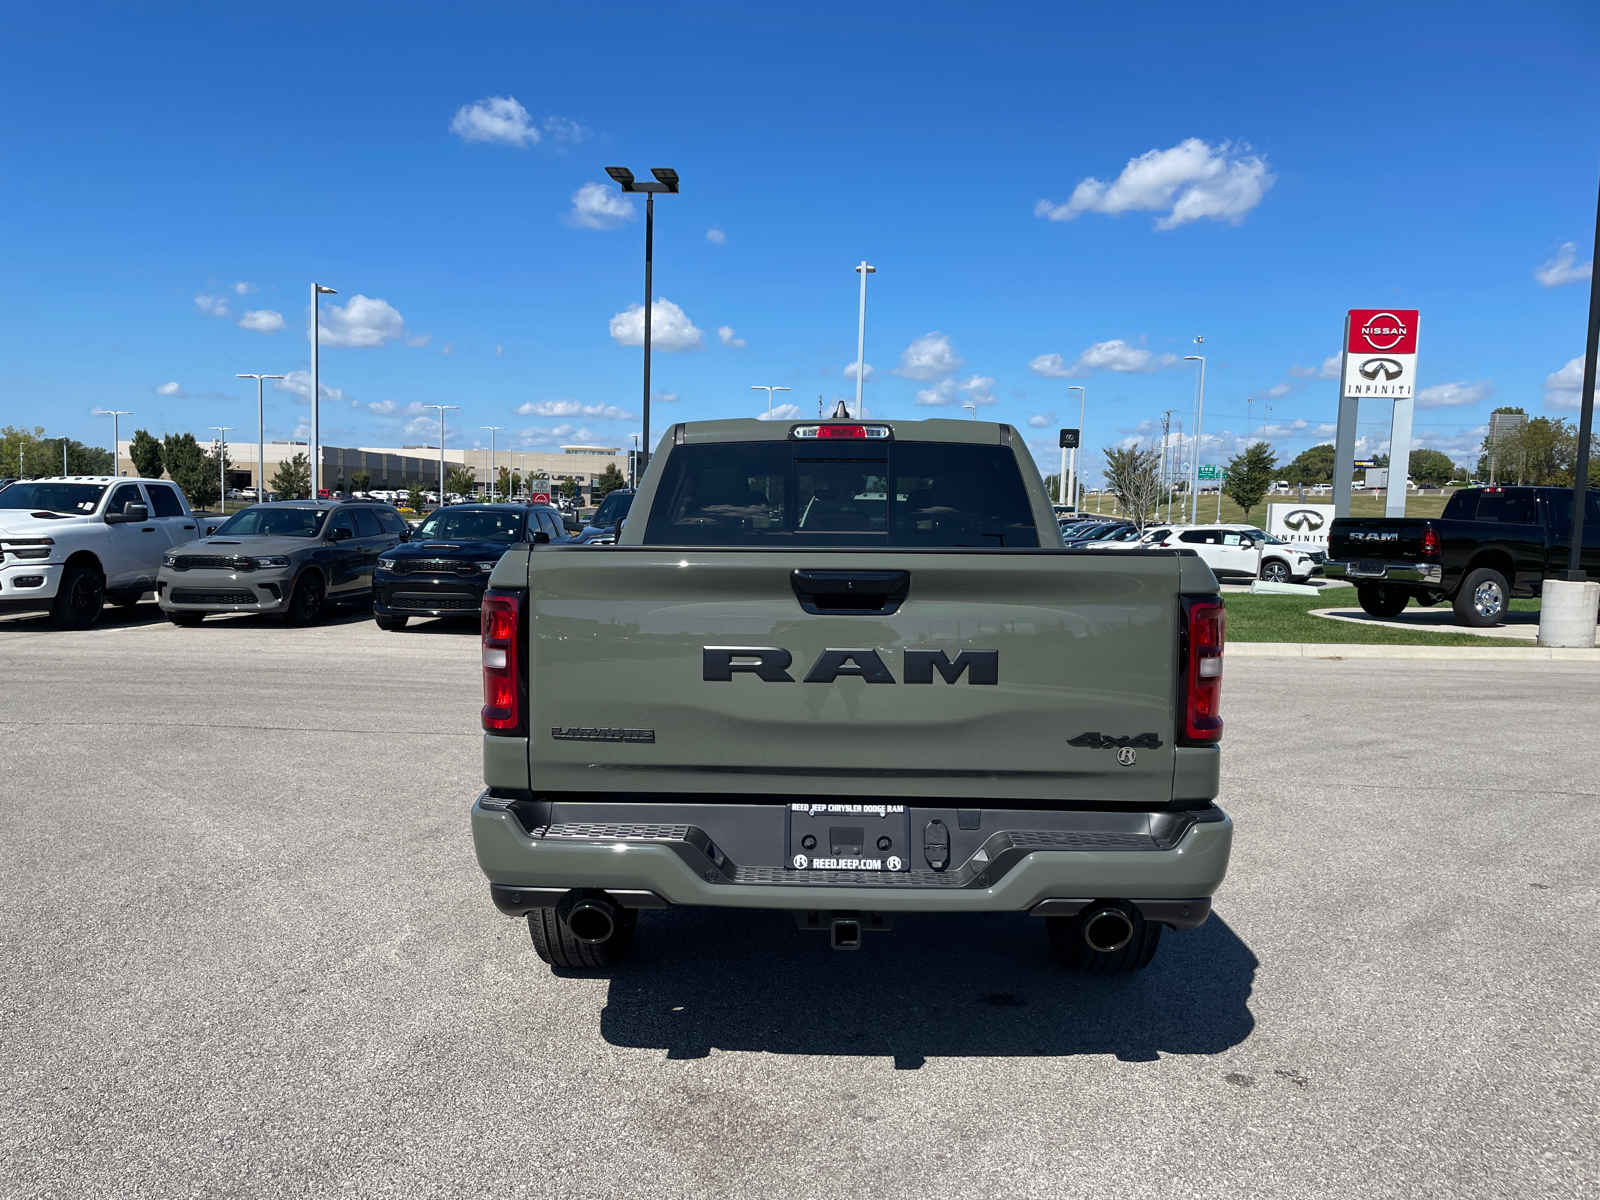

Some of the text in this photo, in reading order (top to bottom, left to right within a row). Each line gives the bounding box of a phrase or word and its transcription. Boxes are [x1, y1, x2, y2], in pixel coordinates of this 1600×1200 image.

[1361, 327, 1407, 336] NISSAN
[1348, 384, 1411, 395] INFINITI
[1349, 532, 1399, 541] RAM
[702, 645, 998, 686] RAM
[791, 803, 809, 811] REED
[828, 804, 862, 812] CHRYSLER
[813, 859, 881, 869] REEDJEEP.COM
